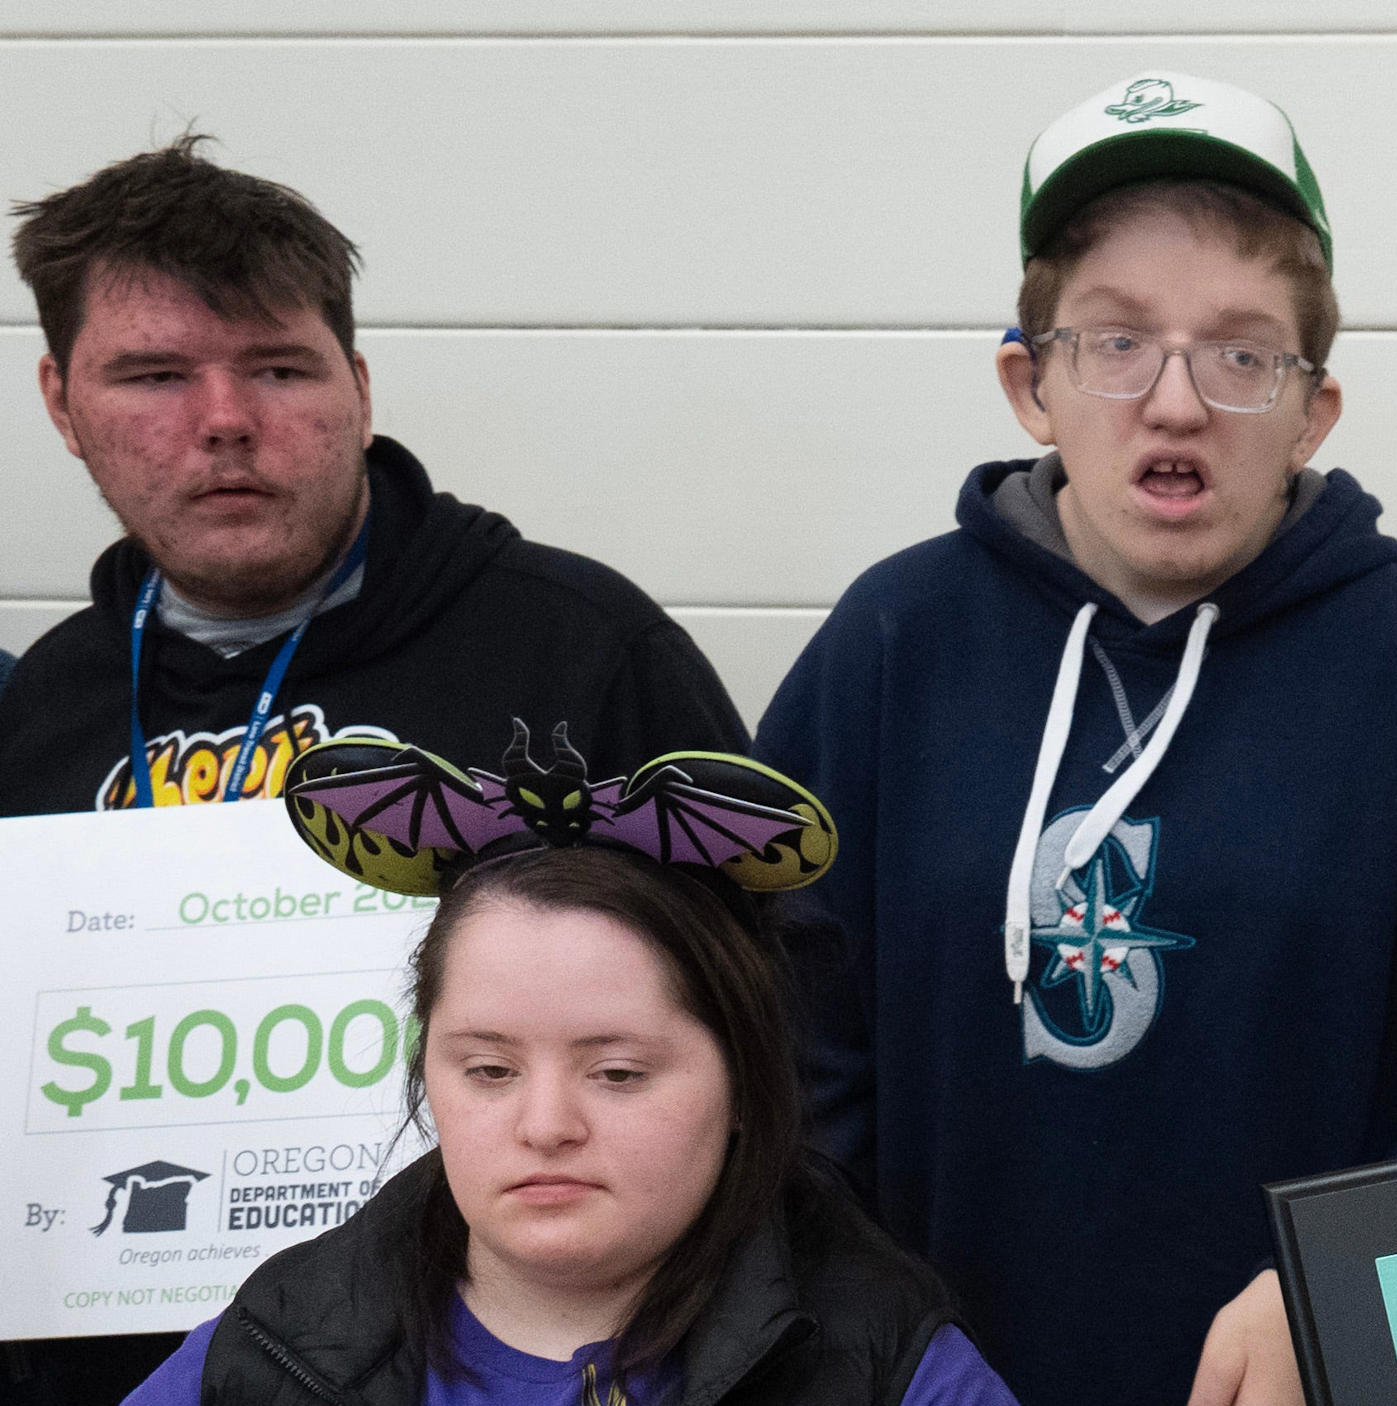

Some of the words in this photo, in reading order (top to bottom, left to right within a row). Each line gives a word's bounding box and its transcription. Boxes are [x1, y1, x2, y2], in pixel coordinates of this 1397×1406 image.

[66, 910, 135, 933] Date:
[179, 887, 342, 925] October
[40, 999, 421, 1118] $10,00
[233, 1142, 383, 1177] OREGON
[229, 1181, 353, 1204] DEPARTMENT
[359, 1179, 383, 1199] OF
[25, 1203, 65, 1232] By:
[228, 1199, 362, 1231] EDUCATIO
[119, 1248, 182, 1268] Oregon
[187, 1244, 261, 1261] achieves
[64, 1290, 112, 1309] COPY
[117, 1287, 155, 1306] NOT
[160, 1284, 239, 1304] NEGOTIA
